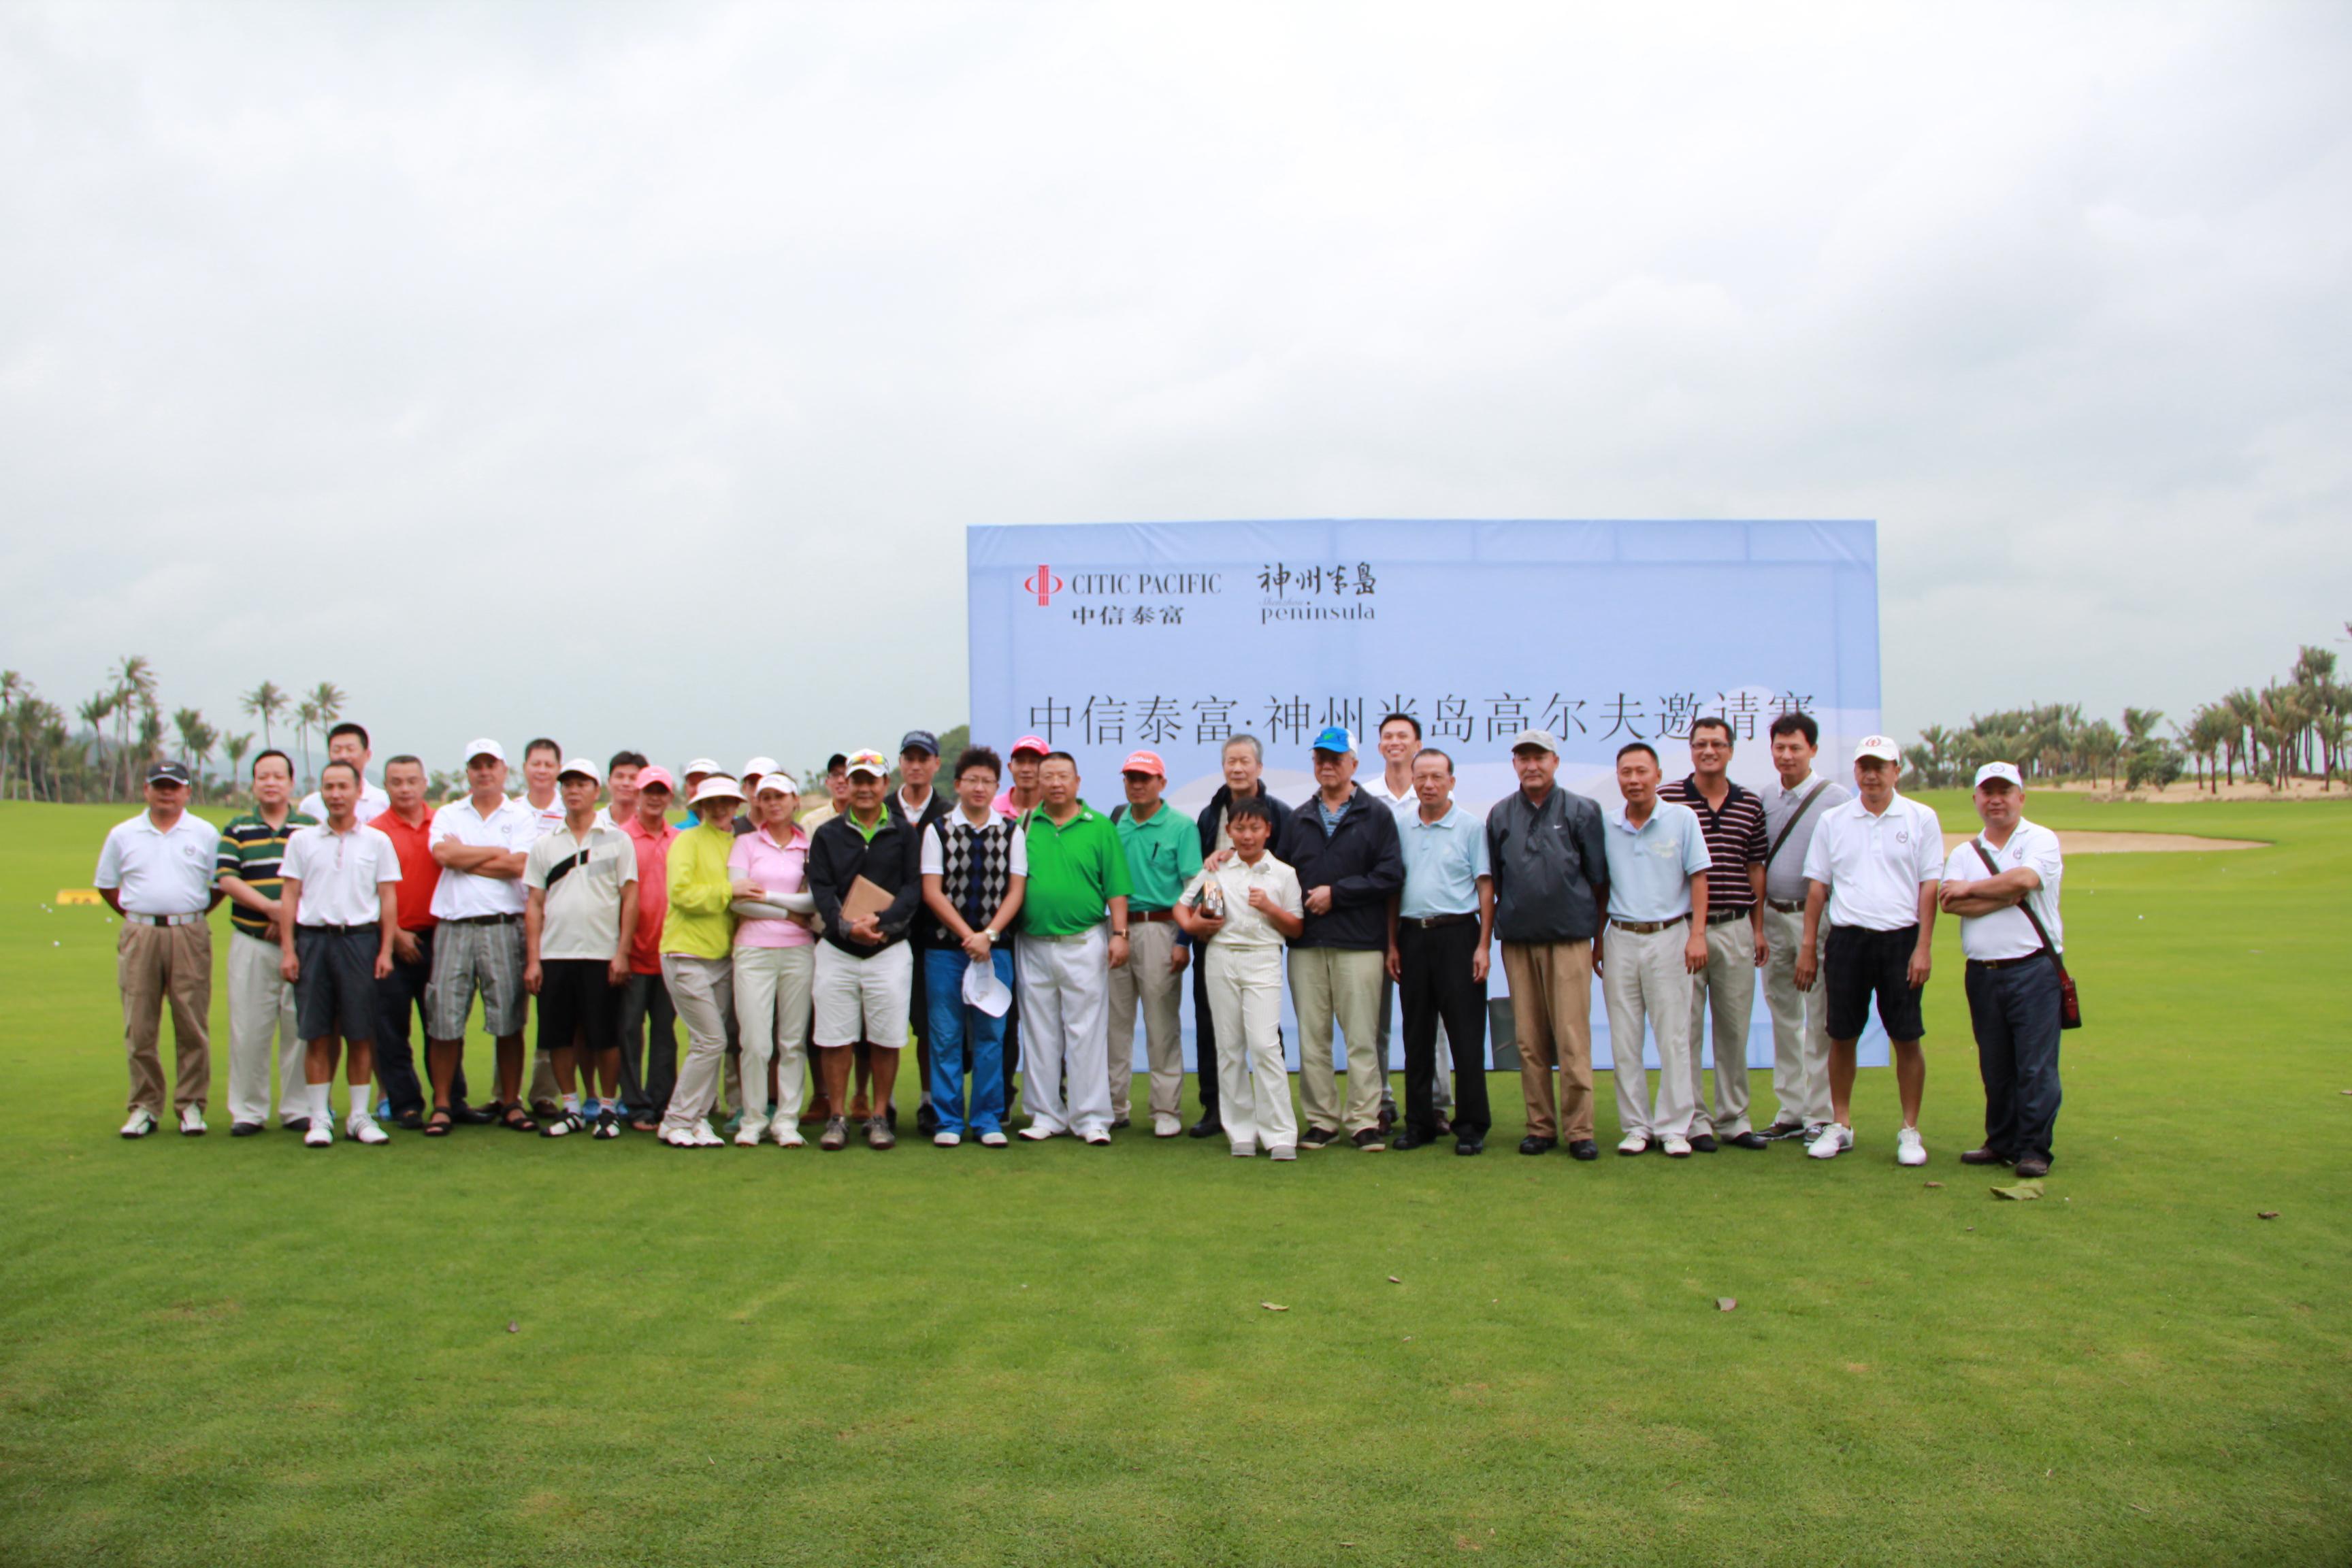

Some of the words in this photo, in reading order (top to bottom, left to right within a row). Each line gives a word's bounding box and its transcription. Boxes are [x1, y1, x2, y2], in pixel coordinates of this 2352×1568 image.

[1072, 573, 1131, 594] CITIC
[1139, 573, 1222, 594] PACIFIC
[1072, 605, 1184, 625] 中信泰富
[1261, 602, 1375, 625] peninsula
